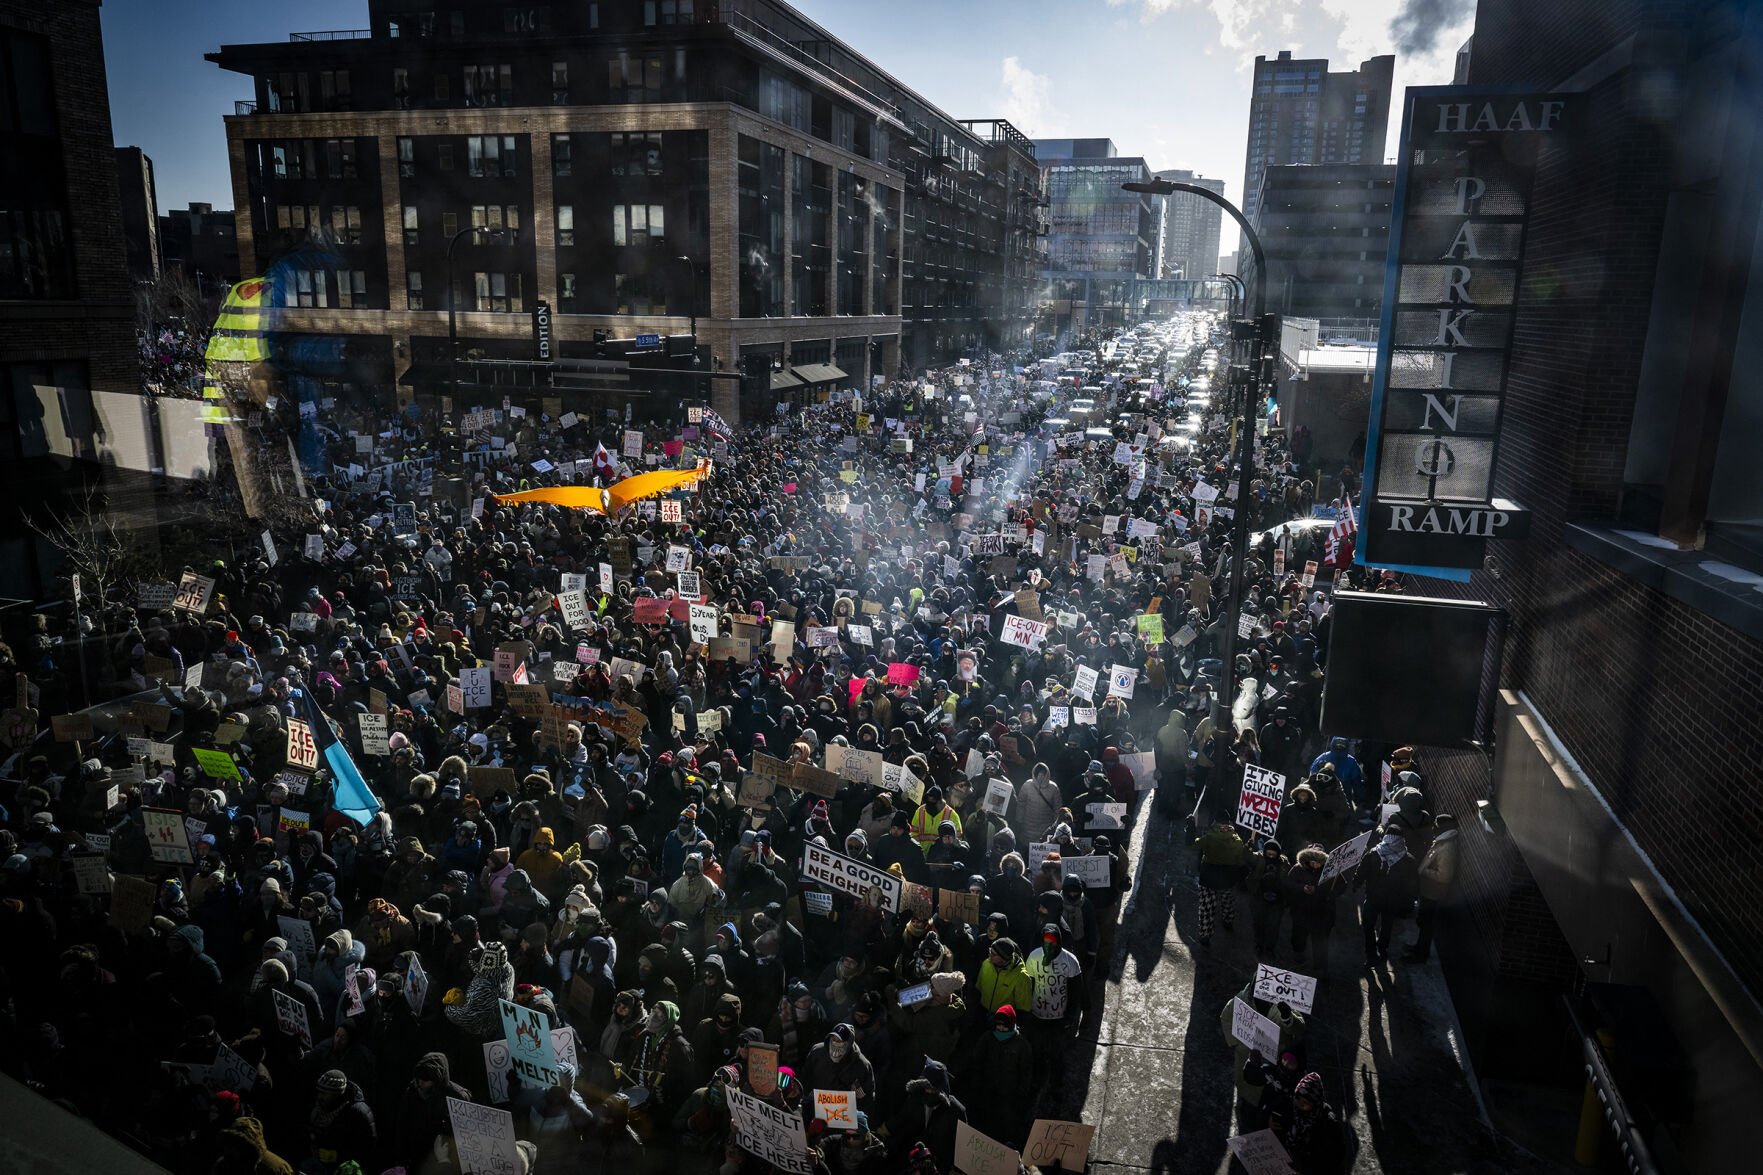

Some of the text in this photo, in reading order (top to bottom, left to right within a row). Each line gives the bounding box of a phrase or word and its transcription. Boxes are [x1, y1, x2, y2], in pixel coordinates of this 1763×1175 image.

[1436, 101, 1565, 133] HAAF
[539, 306, 549, 358] EDITION
[1415, 175, 1487, 477] PARKING
[1388, 504, 1510, 538] RAMP
[986, 542, 1002, 552] MN
[180, 582, 205, 598] ICE
[398, 584, 415, 593] ICE
[563, 594, 580, 602] ICE
[176, 592, 203, 606] OUT!
[566, 602, 580, 610] OUT
[568, 610, 584, 618] FOR
[568, 618, 588, 627] GOOD
[1006, 616, 1046, 634] ICE-OUT
[1013, 632, 1032, 645] MN
[290, 728, 314, 748] ICE
[290, 747, 316, 766] OUT!
[1246, 766, 1279, 785] IT'S
[1244, 779, 1283, 800] GIVING
[1241, 791, 1280, 819] NAZIS
[1239, 809, 1276, 836] VIBES
[809, 850, 892, 892] BE A GOOD
[1067, 860, 1101, 872] RESIST
[808, 863, 892, 908] NEIGHBR
[949, 893, 976, 910] ICE
[1261, 968, 1292, 984] ICE
[503, 1006, 541, 1029] M N
[1238, 1003, 1258, 1023] STOP
[218, 1046, 256, 1081] DE-ICE
[511, 1057, 558, 1086] MELTS
[817, 1094, 847, 1105] ABOLISH
[450, 1100, 505, 1125] KRISTI
[730, 1090, 800, 1130] WE MELT
[1045, 1124, 1072, 1141] ICE
[736, 1134, 811, 1174] ICE HERE
[966, 1135, 1006, 1162] ABOLISH
[1031, 1142, 1075, 1161] OUT
[970, 1154, 989, 1173] ICE
